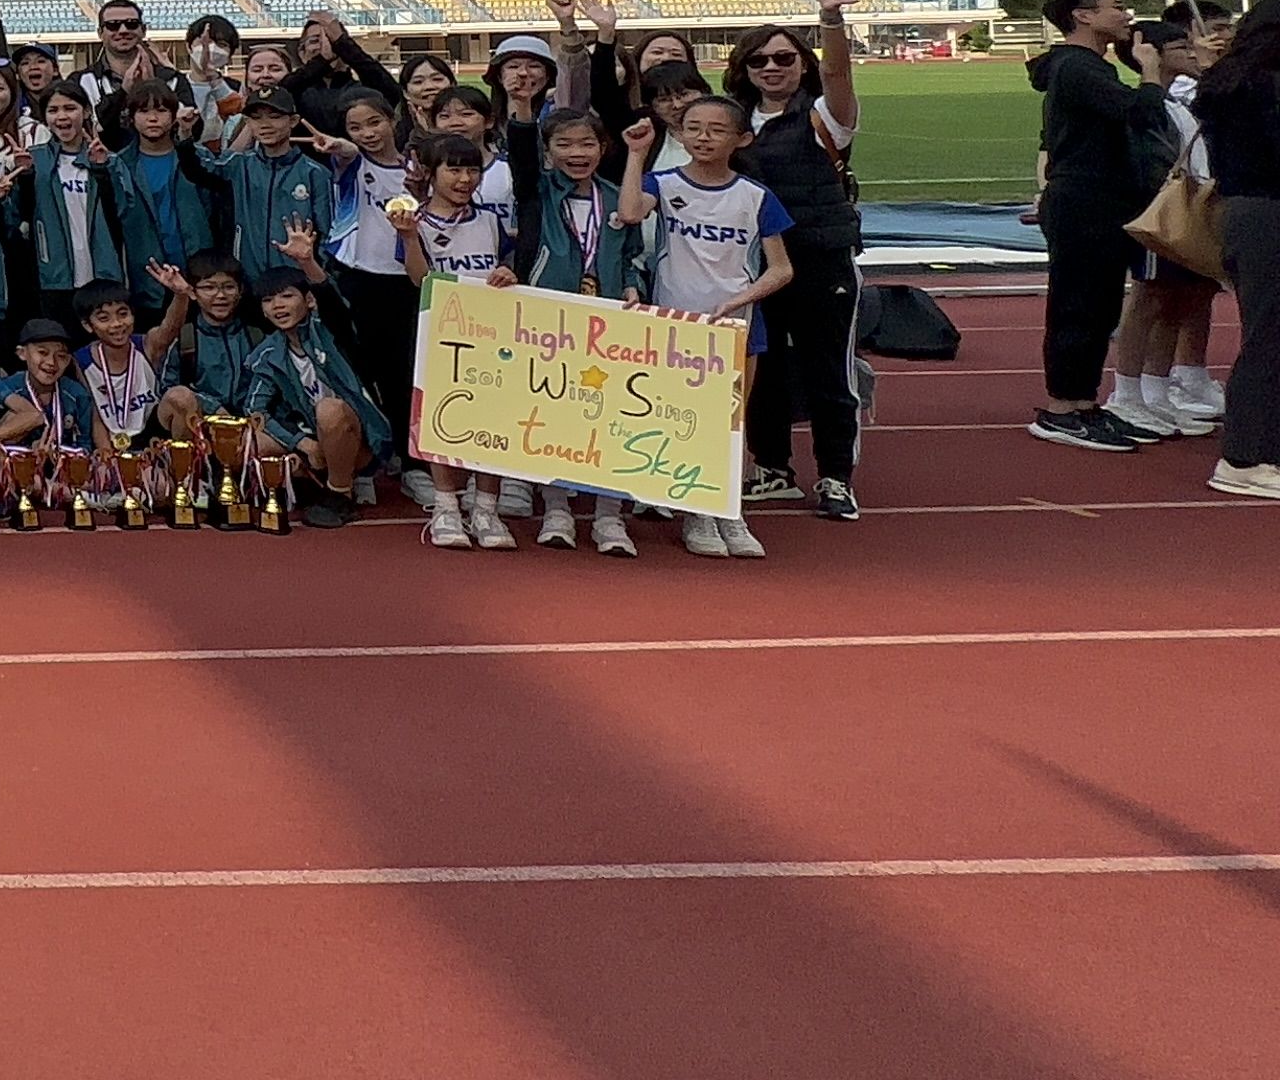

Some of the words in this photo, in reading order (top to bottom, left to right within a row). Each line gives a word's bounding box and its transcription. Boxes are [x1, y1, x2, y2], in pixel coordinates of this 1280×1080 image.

[435, 254, 498, 273] TWSP
[666, 216, 748, 245] TWSPS
[439, 291, 497, 339] Aim
[514, 301, 575, 362] high
[585, 315, 658, 367] Reach
[666, 326, 724, 387] high
[440, 341, 503, 388] Tsoi
[529, 357, 604, 420] Wing
[620, 372, 697, 441] Sing
[432, 390, 509, 451] Can
[517, 405, 603, 467] touch
[612, 431, 721, 500] Sky
